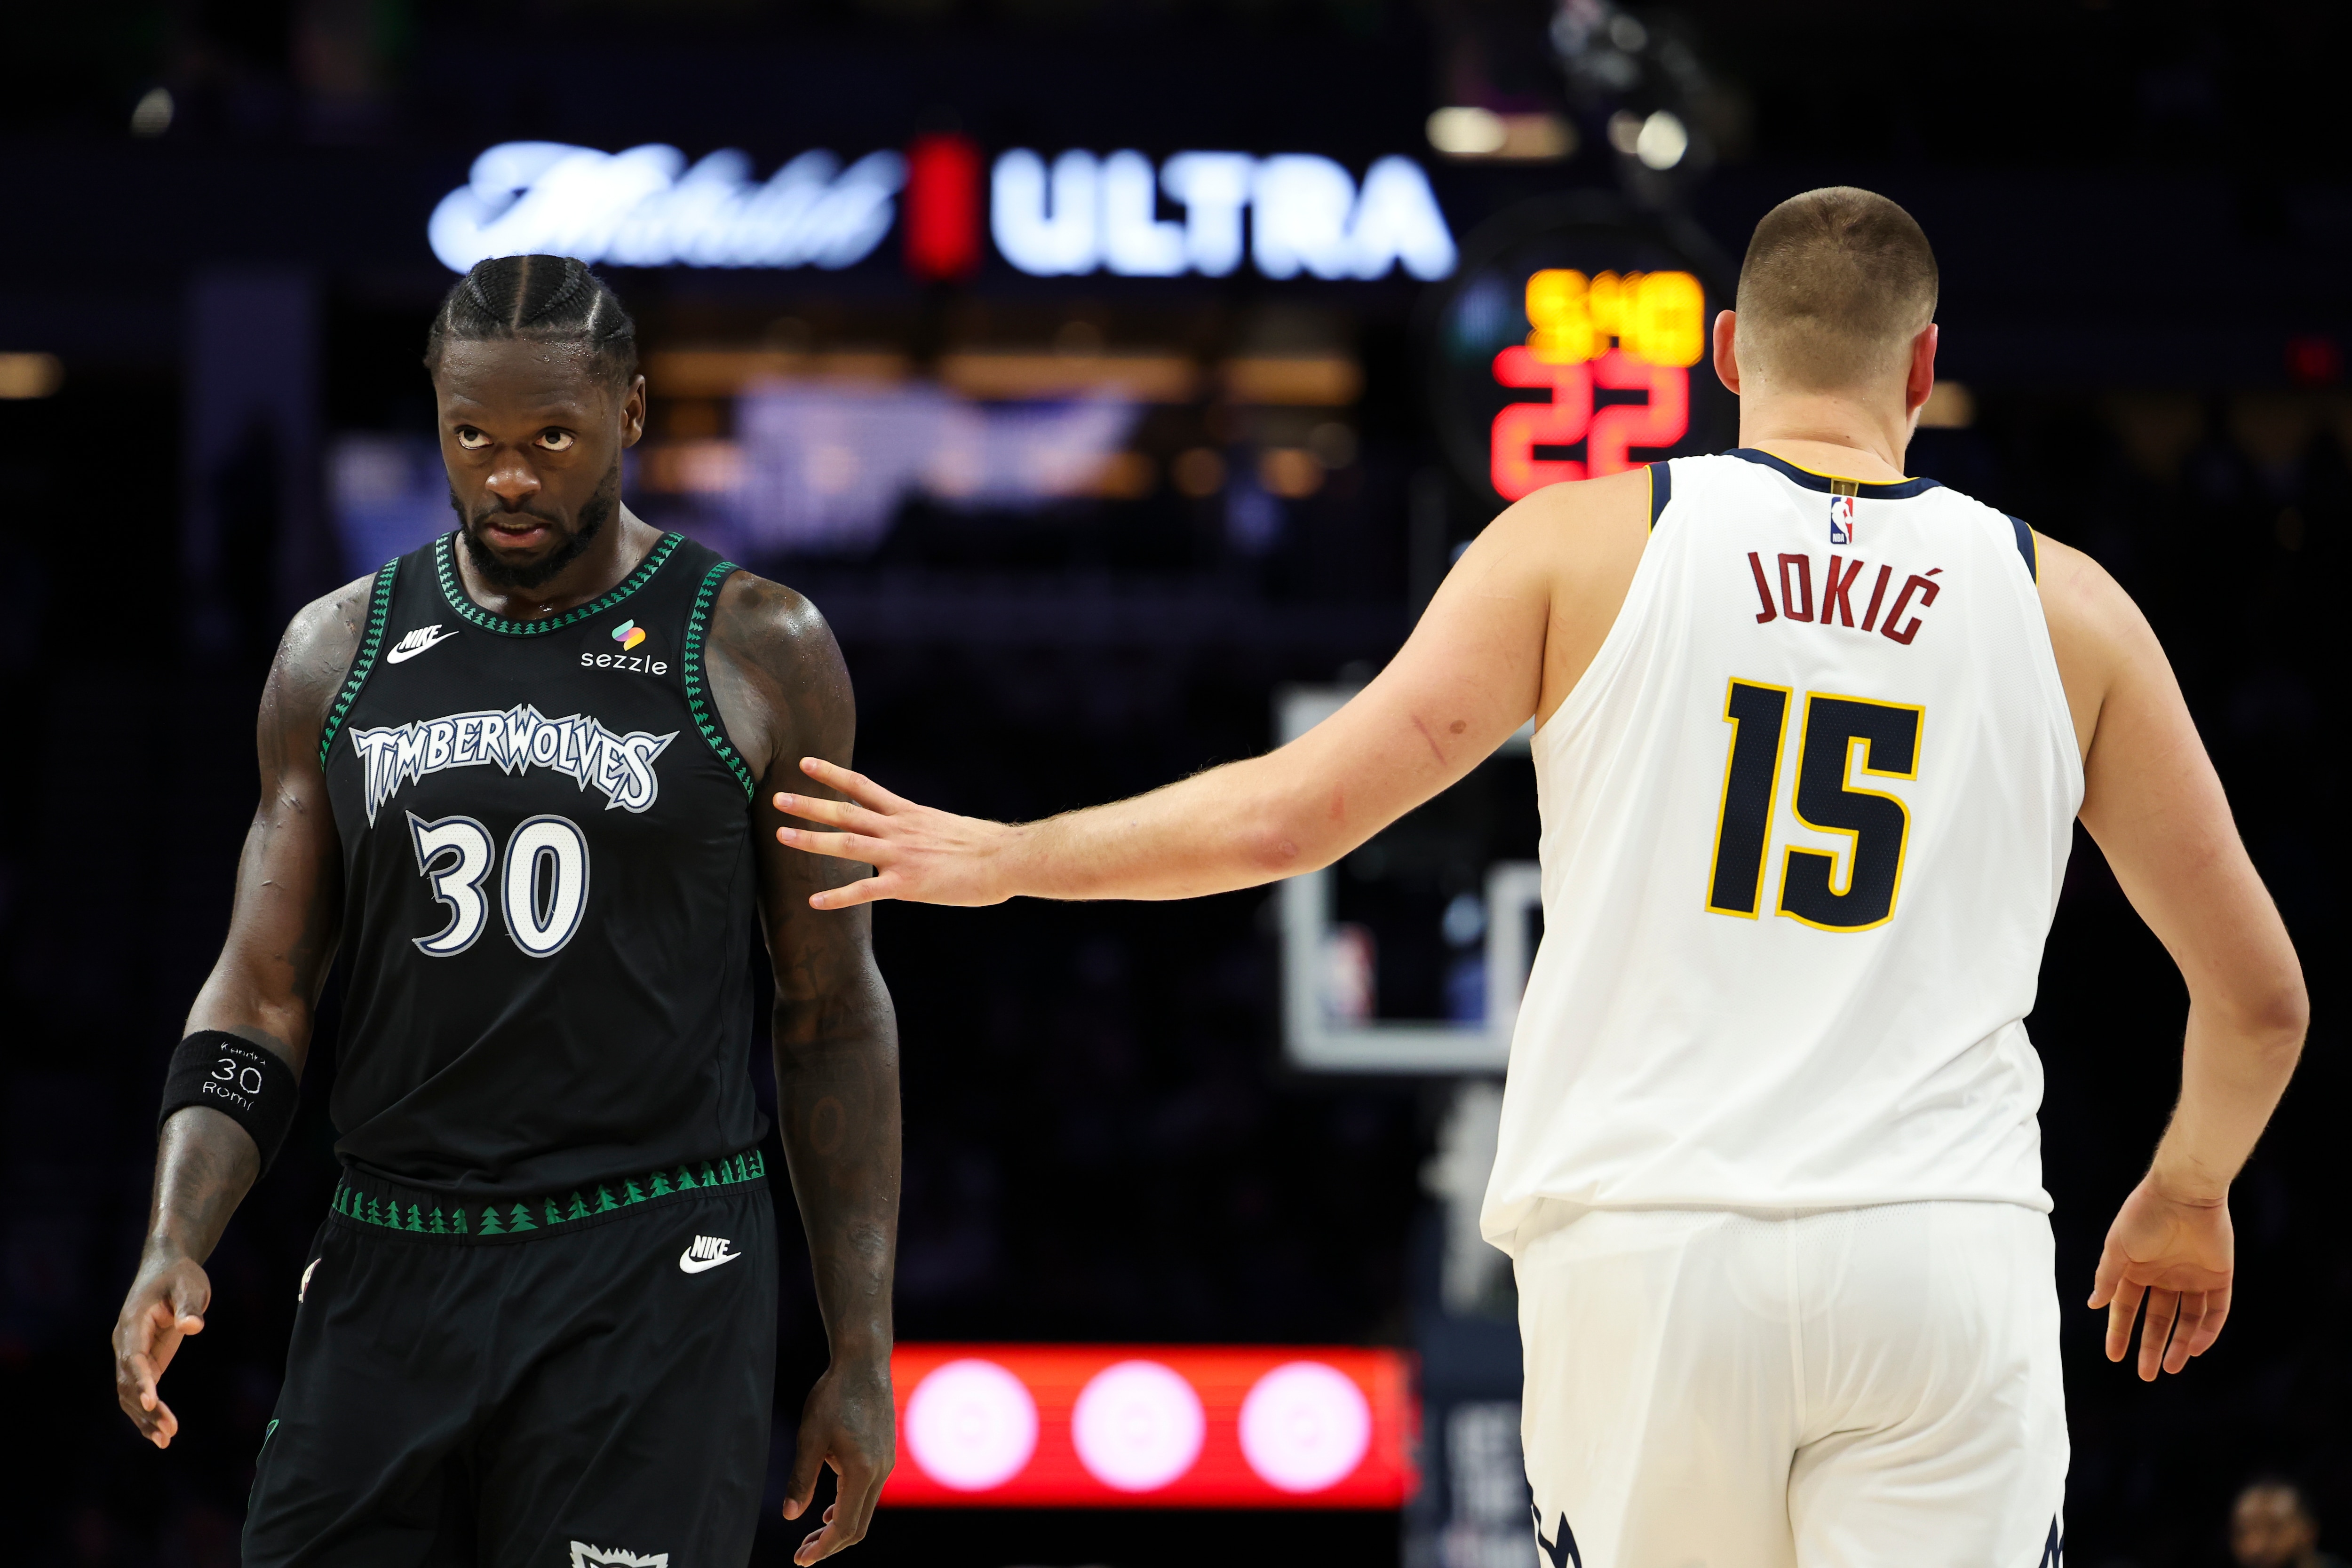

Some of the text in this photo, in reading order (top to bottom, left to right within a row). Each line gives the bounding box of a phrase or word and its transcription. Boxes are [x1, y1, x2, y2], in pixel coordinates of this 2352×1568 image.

[992, 149, 1458, 281] ULTRA
[1491, 346, 1689, 502] 22
[1832, 533, 1845, 543] NBA
[398, 624, 443, 649] NIKE
[1747, 551, 1944, 645] JOKIĆ
[580, 653, 668, 675] sezzle
[349, 703, 680, 829] TIMBERWOLVES
[1705, 676, 1925, 933] 15
[406, 810, 590, 958] 30
[211, 1058, 262, 1094] 30
[690, 1235, 731, 1259] NIKE
